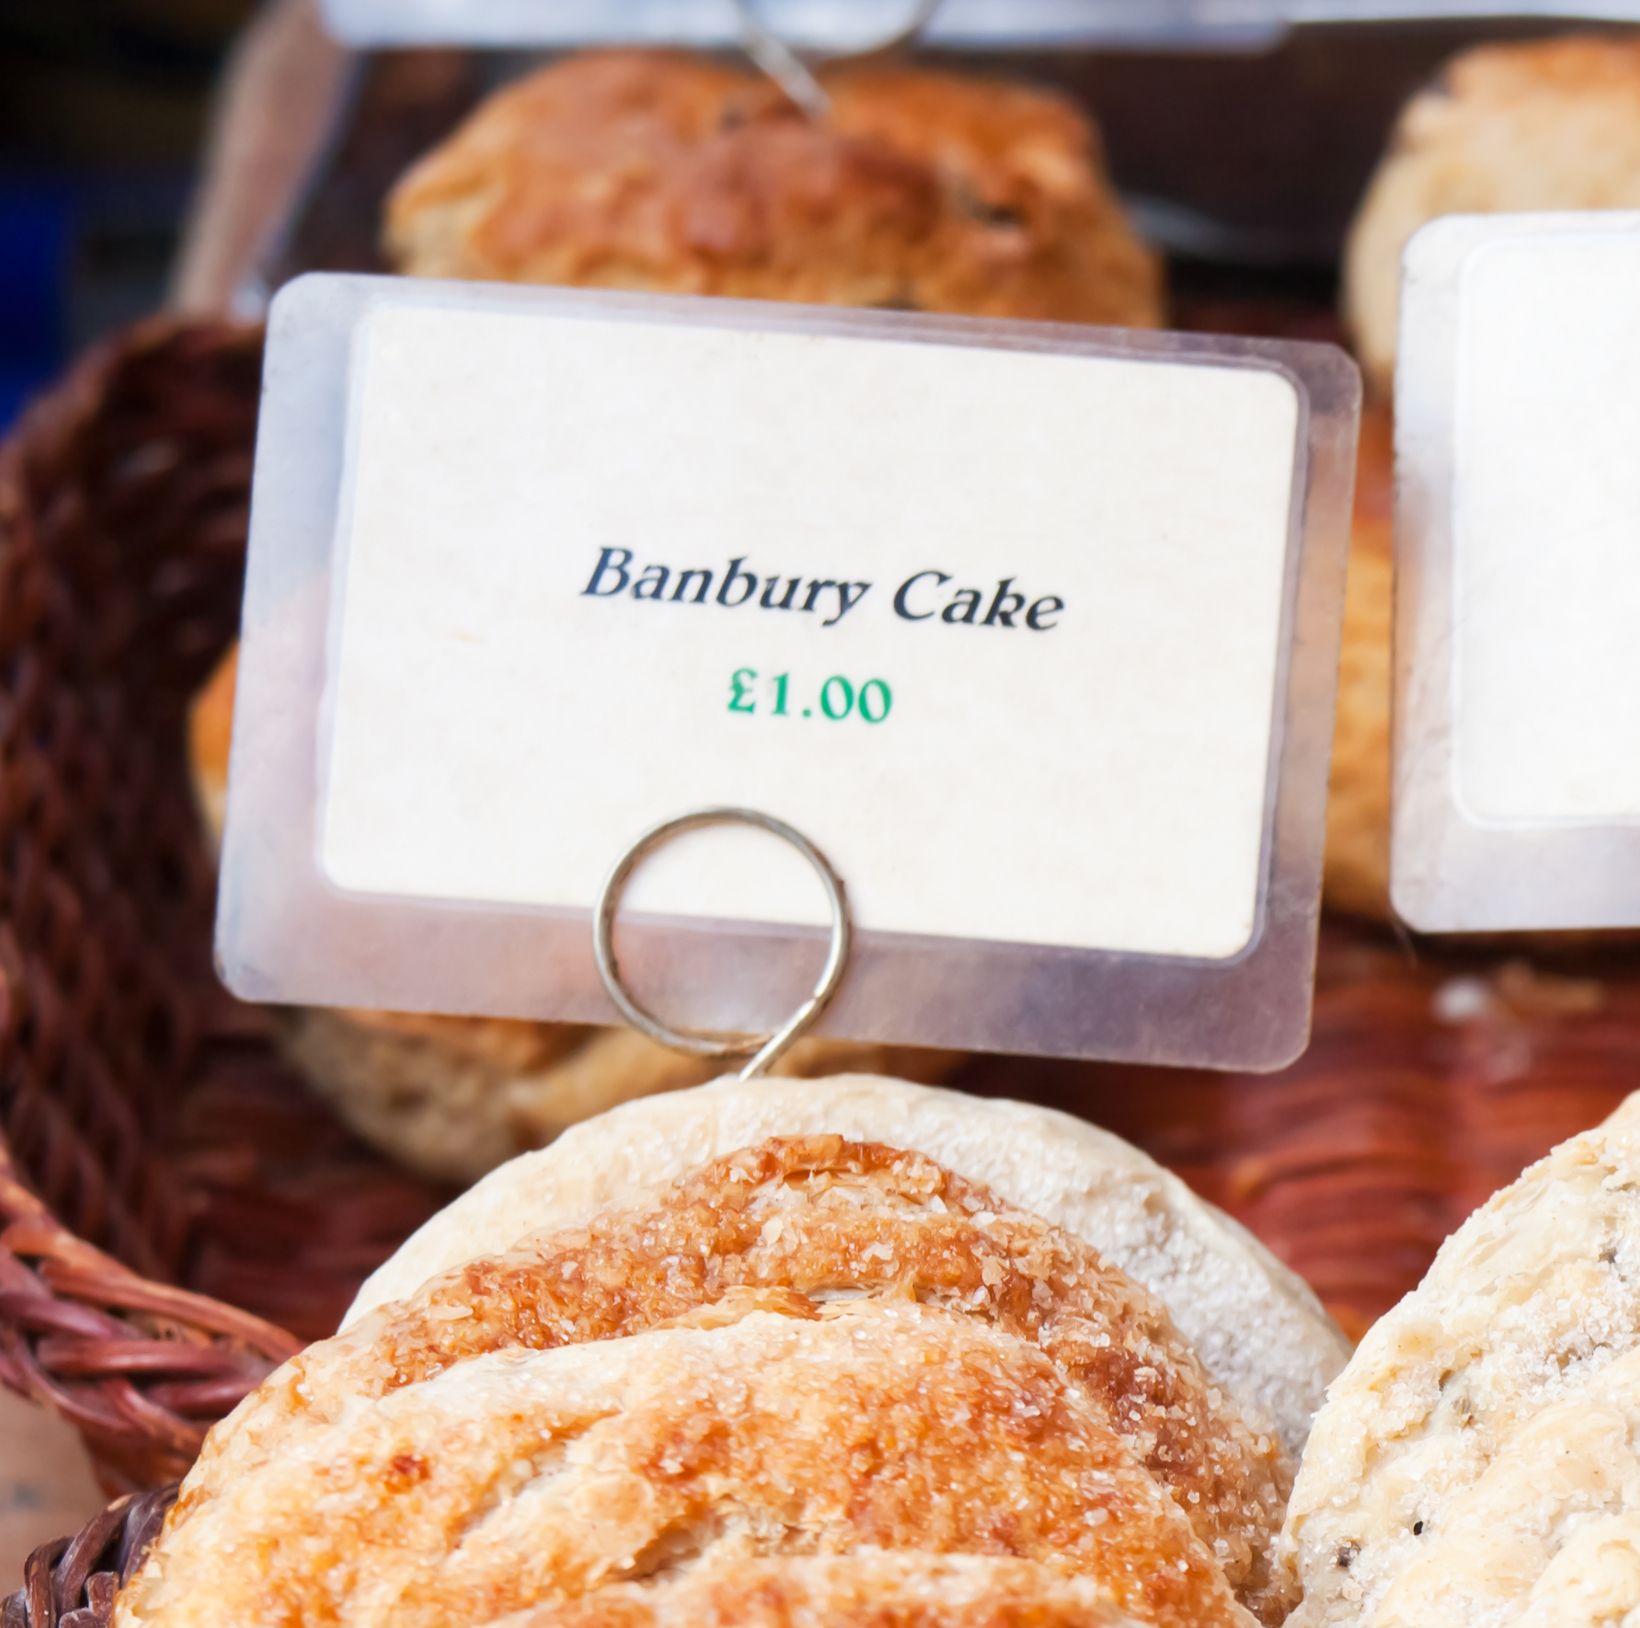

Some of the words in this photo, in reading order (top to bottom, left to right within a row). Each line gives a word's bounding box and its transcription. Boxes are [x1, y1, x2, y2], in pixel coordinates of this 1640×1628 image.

[581, 546, 872, 627] Banbury
[893, 570, 1065, 632] Cake
[727, 667, 893, 725] £1.00
